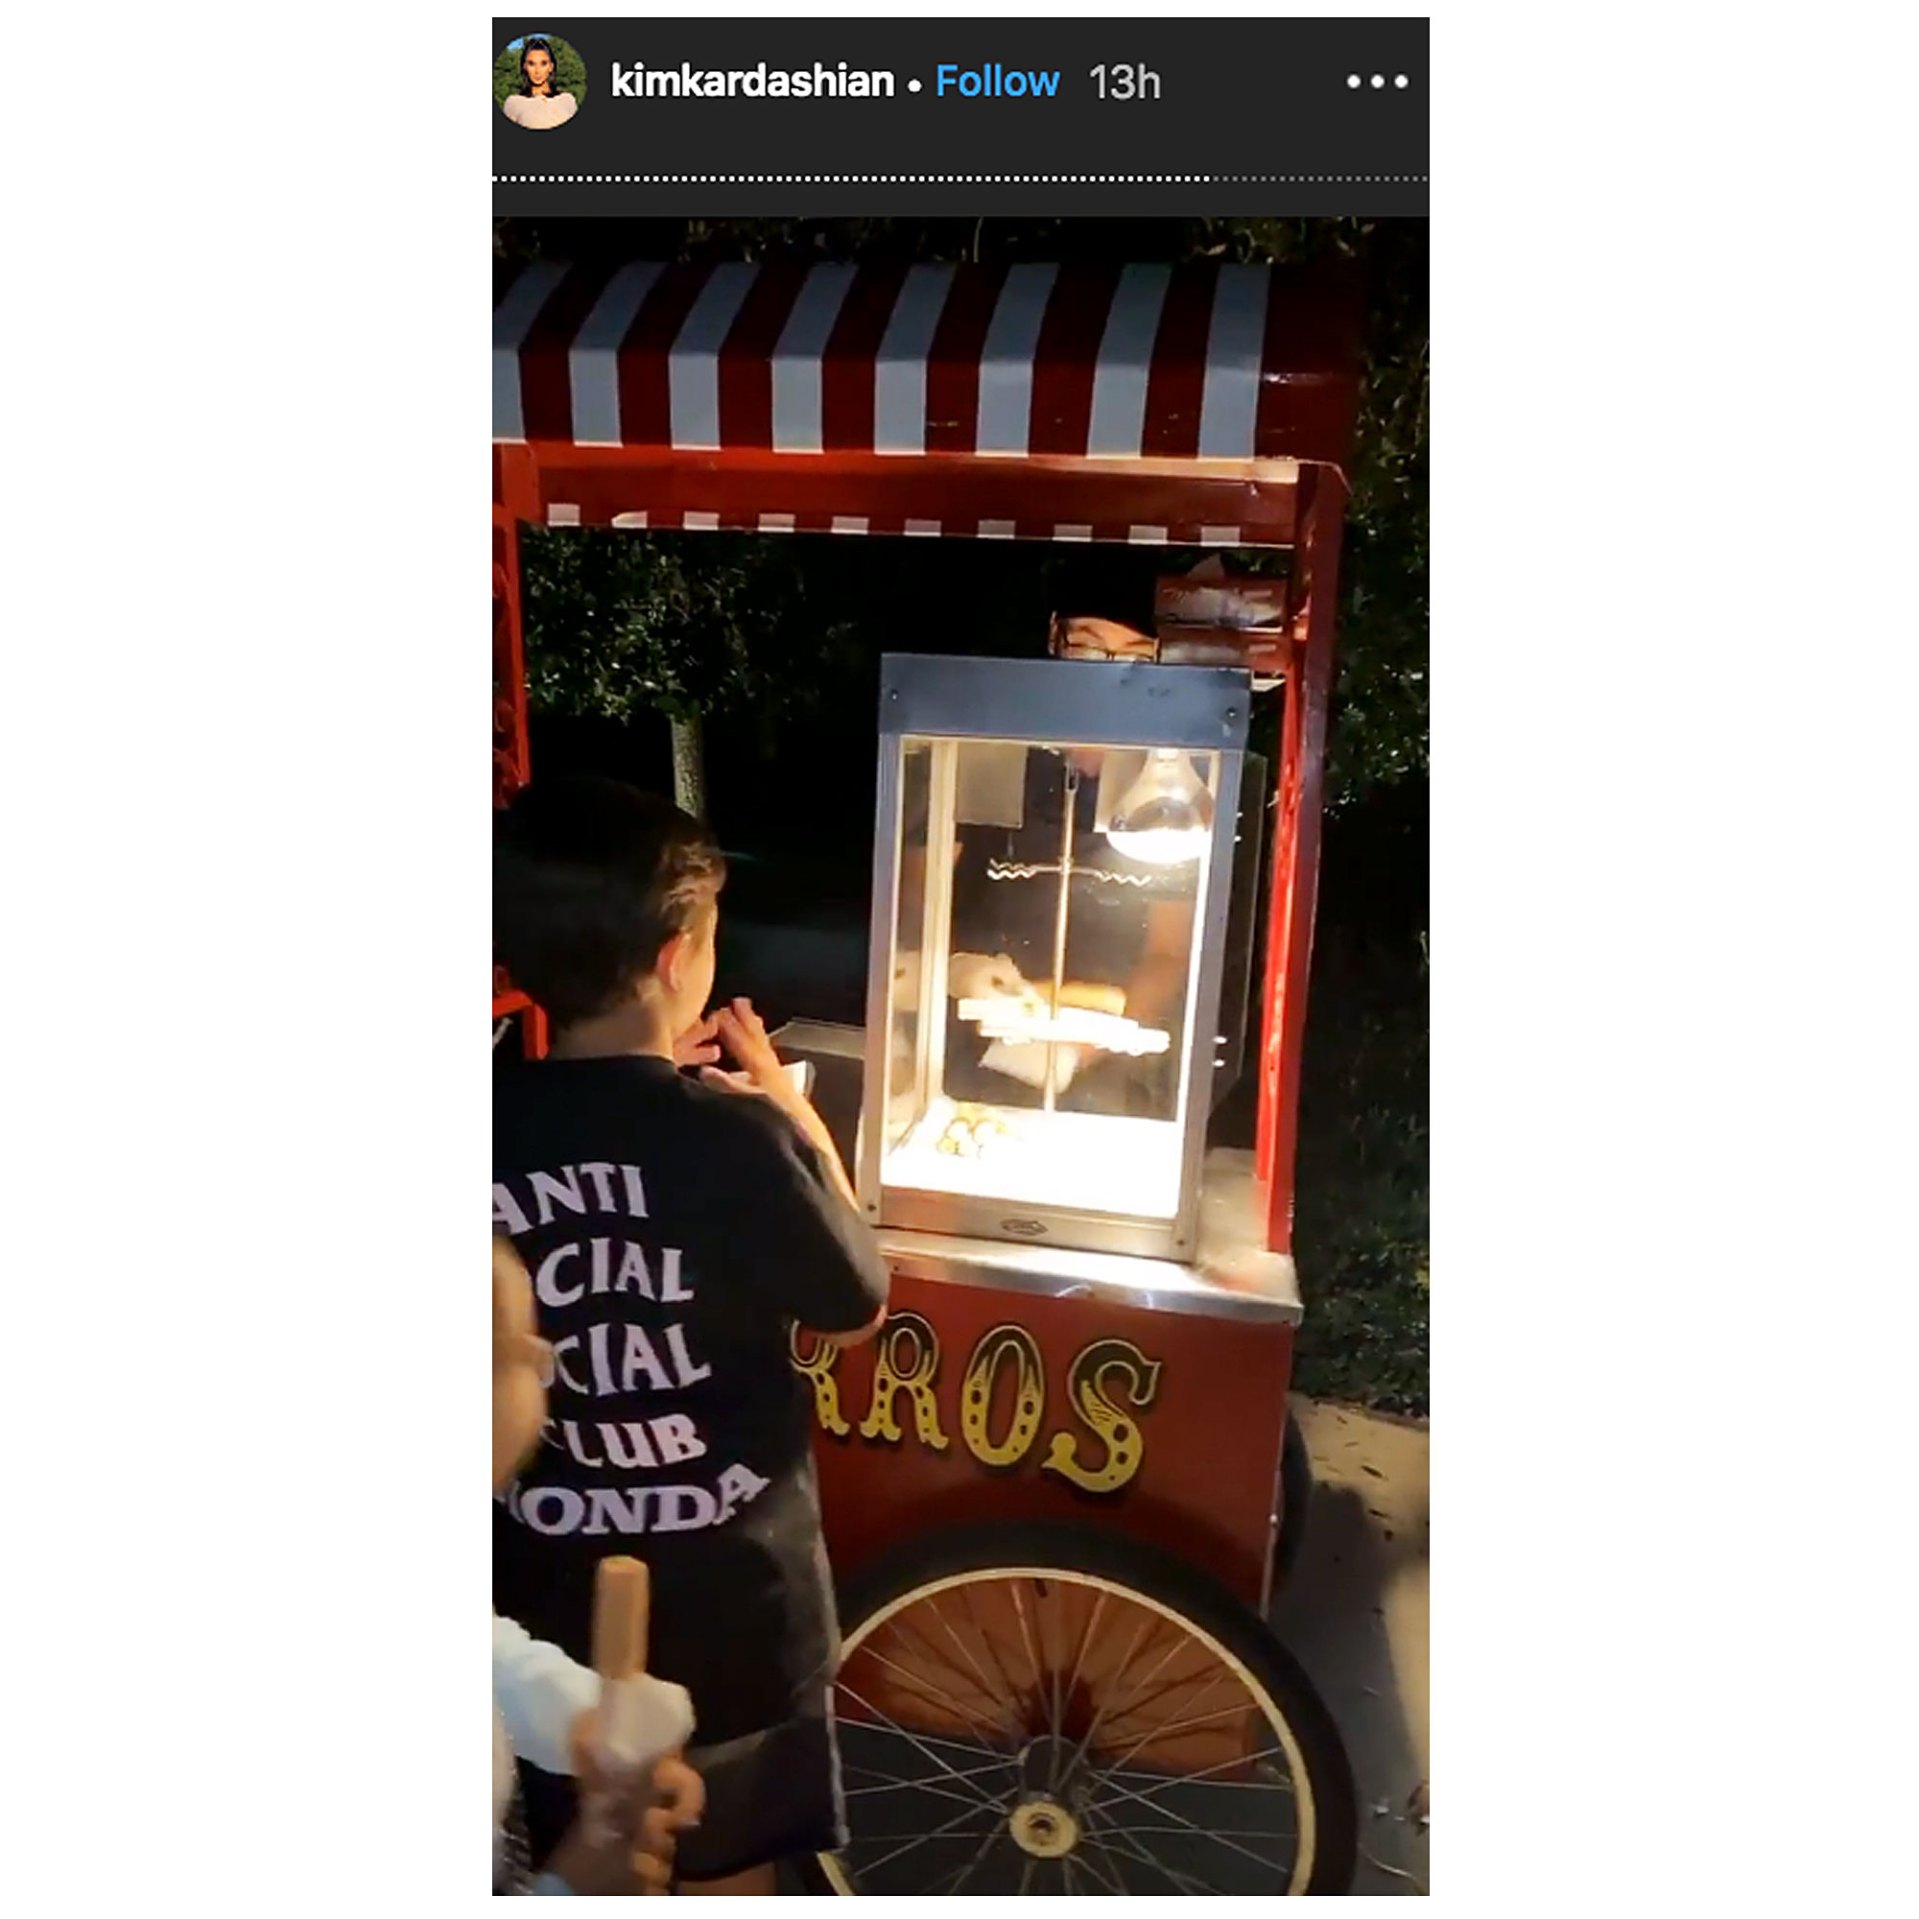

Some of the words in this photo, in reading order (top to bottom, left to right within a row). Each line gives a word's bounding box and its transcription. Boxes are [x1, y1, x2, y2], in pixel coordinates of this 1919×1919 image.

[536, 1237, 695, 1308] CIAL
[554, 1322, 713, 1397] CIAL
[789, 1312, 1163, 1493] RROS
[508, 1463, 771, 1536] ONDA
